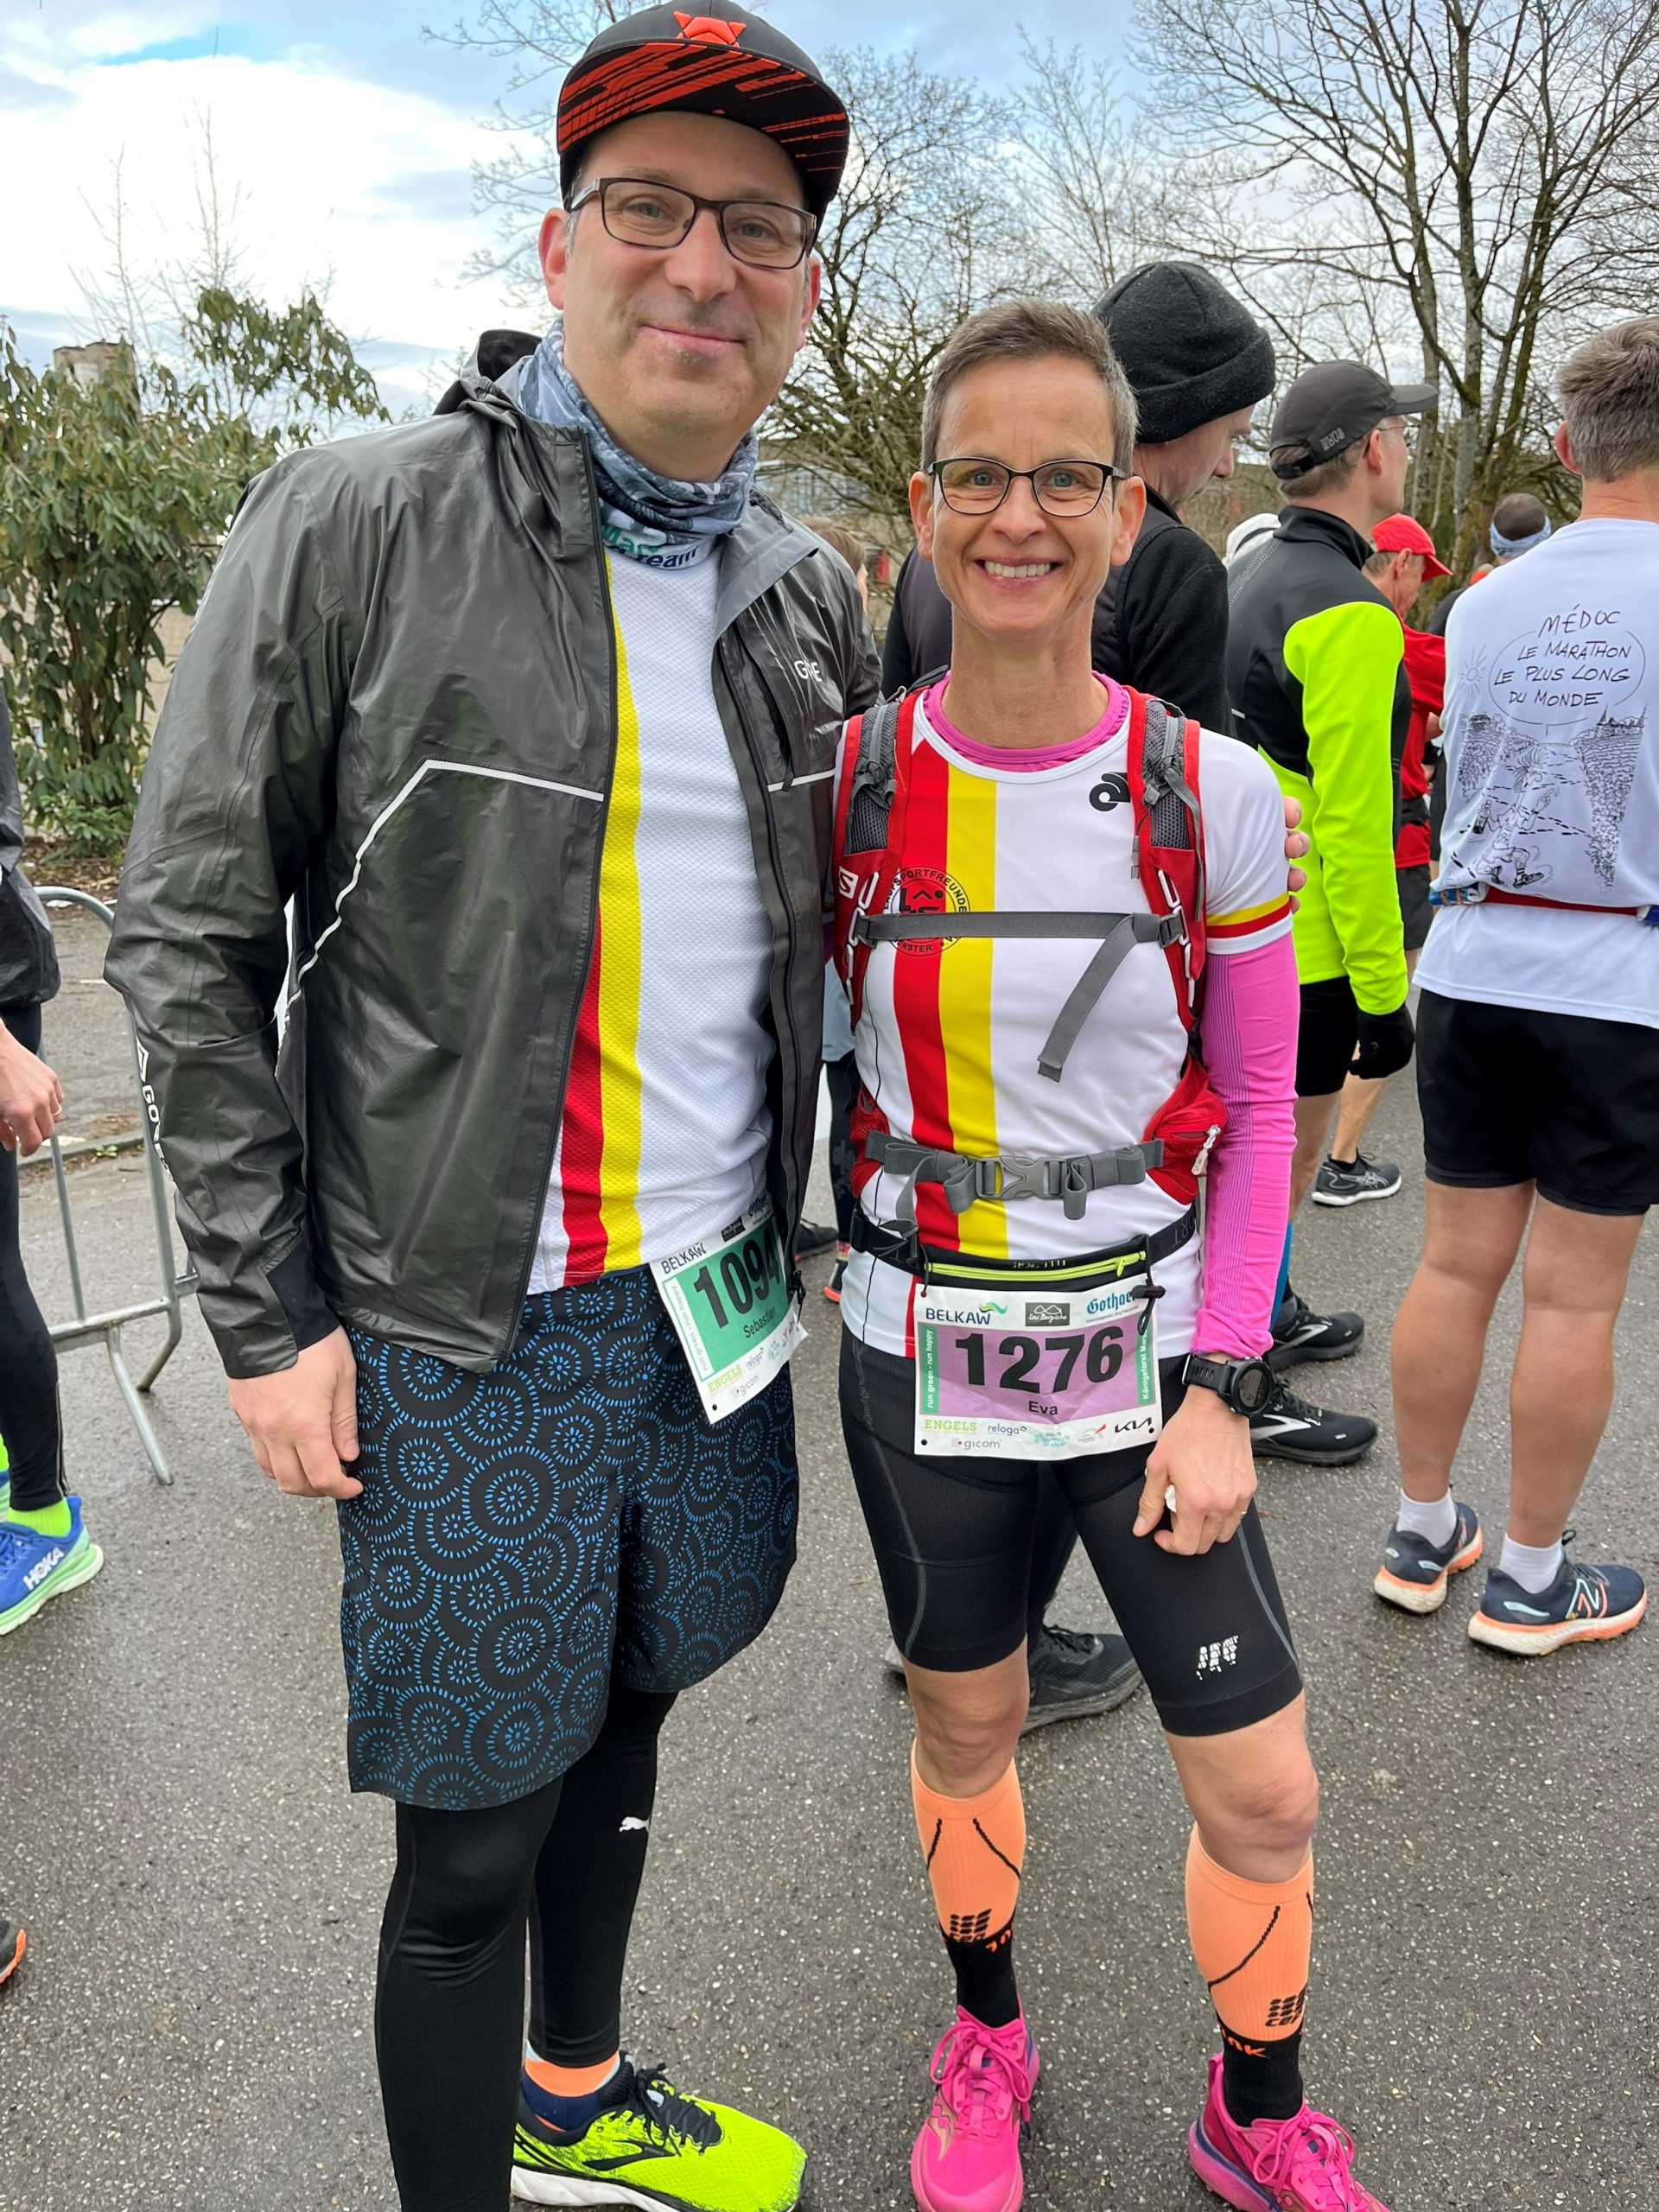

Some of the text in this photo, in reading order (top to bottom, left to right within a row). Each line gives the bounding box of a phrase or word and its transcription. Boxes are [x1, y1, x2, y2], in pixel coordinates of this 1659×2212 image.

[1537, 603, 1621, 638] MÉDOC
[1517, 641, 1632, 661] LE MARATHON
[1493, 664, 1631, 686] LE PLUS LONG
[1509, 690, 1605, 708] DU MONDE
[662, 1242, 707, 1274] BELKAW
[694, 1225, 781, 1329] 1094
[925, 1307, 991, 1325] BELKAW
[925, 1329, 934, 1351] happy
[956, 1325, 1124, 1395] 1276
[1141, 1353, 1150, 1400] Königsforst
[1028, 1400, 1058, 1415] Eva
[925, 1419, 977, 1432] ENGELS
[988, 1423, 1020, 1436] reloga
[963, 1440, 1001, 1450] gicom
[23, 1547, 65, 1591] HOKA
